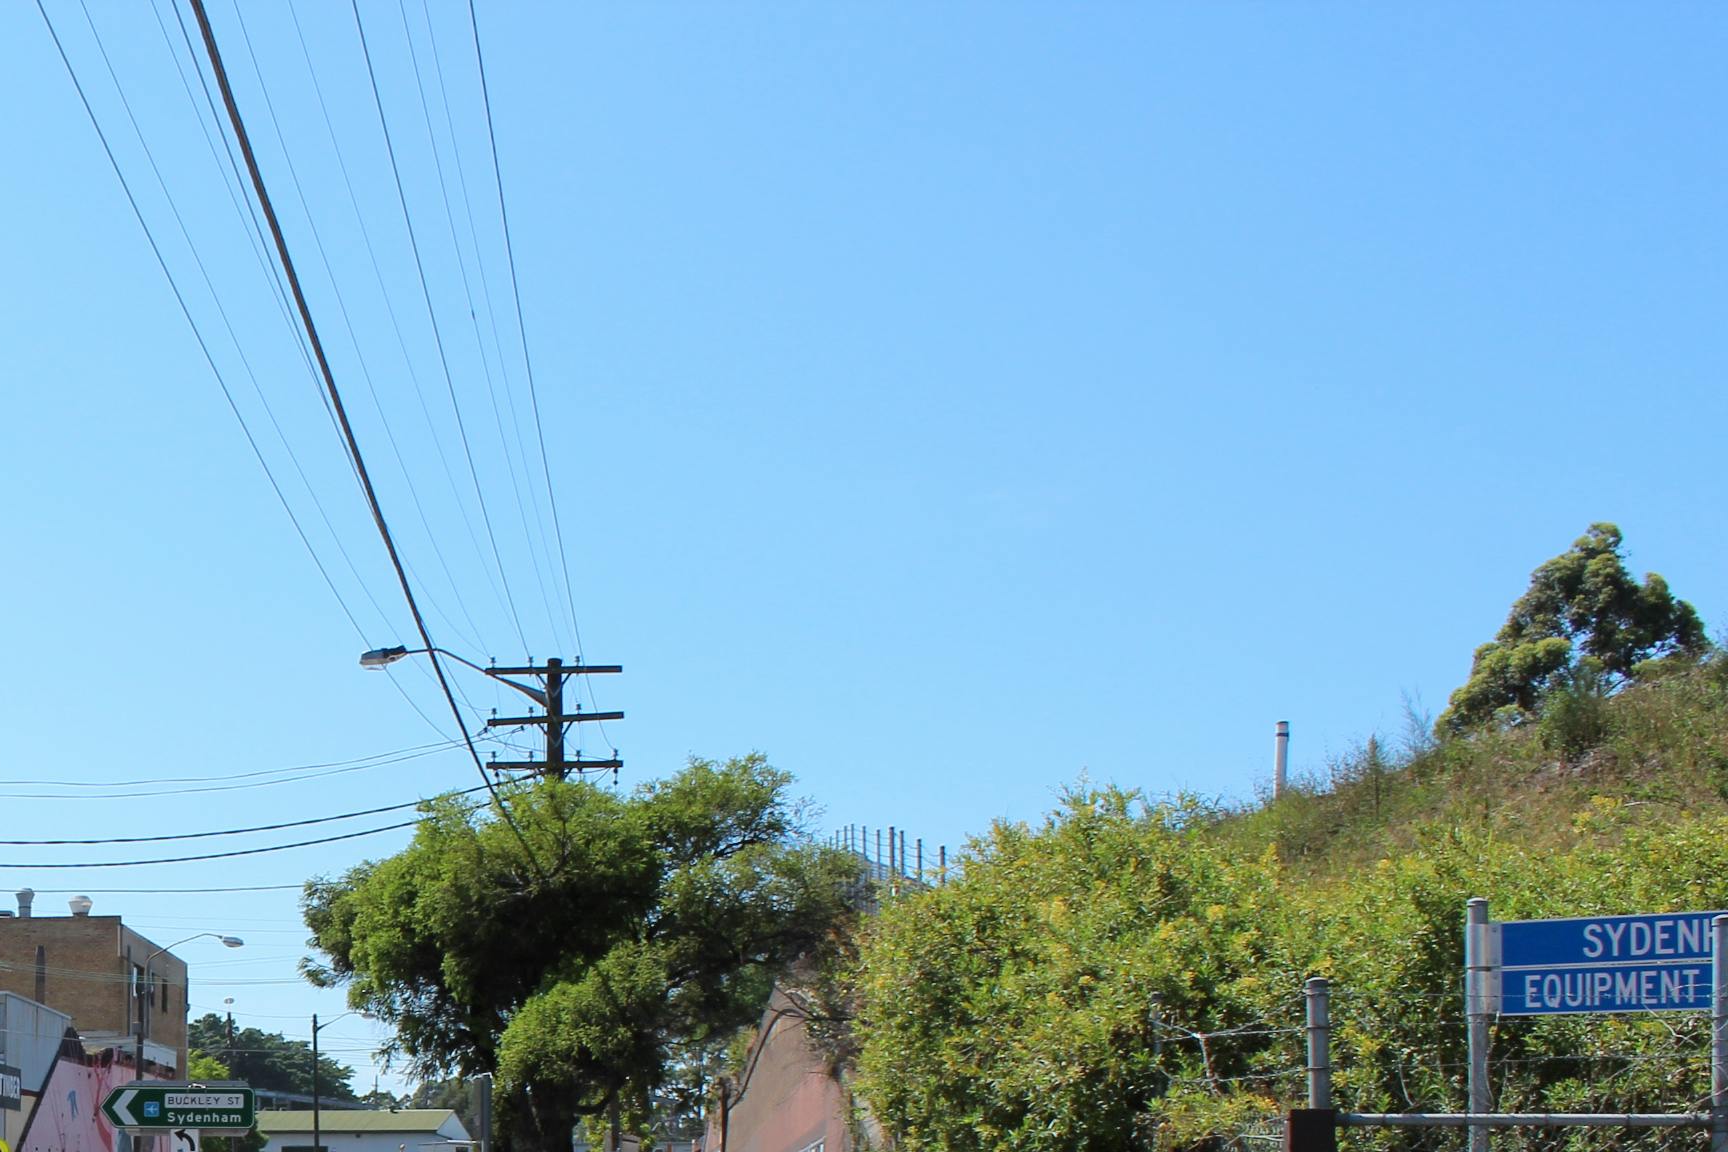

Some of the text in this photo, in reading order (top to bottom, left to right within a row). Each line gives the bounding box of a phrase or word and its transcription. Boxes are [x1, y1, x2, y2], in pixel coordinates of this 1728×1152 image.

[1524, 969, 1701, 1009] EQUIPMENT
[167, 1096, 241, 1106] BUCKLEY ST
[167, 1112, 242, 1125] Sydenham
